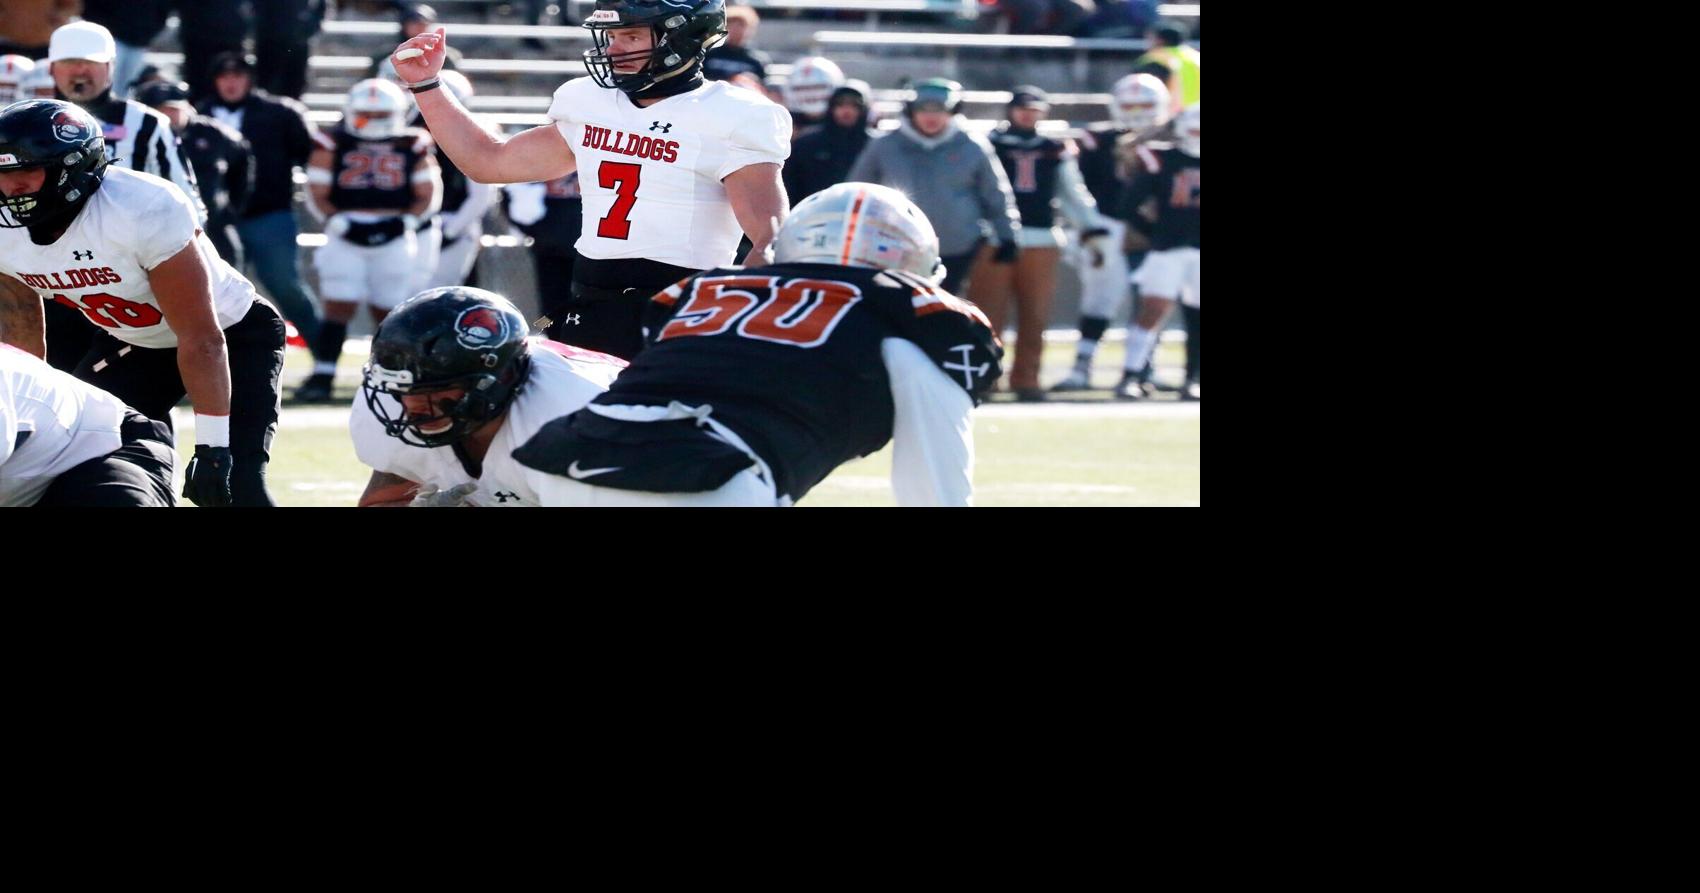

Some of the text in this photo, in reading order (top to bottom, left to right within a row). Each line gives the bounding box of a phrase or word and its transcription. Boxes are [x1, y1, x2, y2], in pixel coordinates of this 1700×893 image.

[582, 124, 680, 163] BULLDOGS
[339, 150, 407, 190] 25
[597, 160, 642, 240] 7
[16, 267, 122, 290] BULLDOGS
[655, 275, 863, 348] 50
